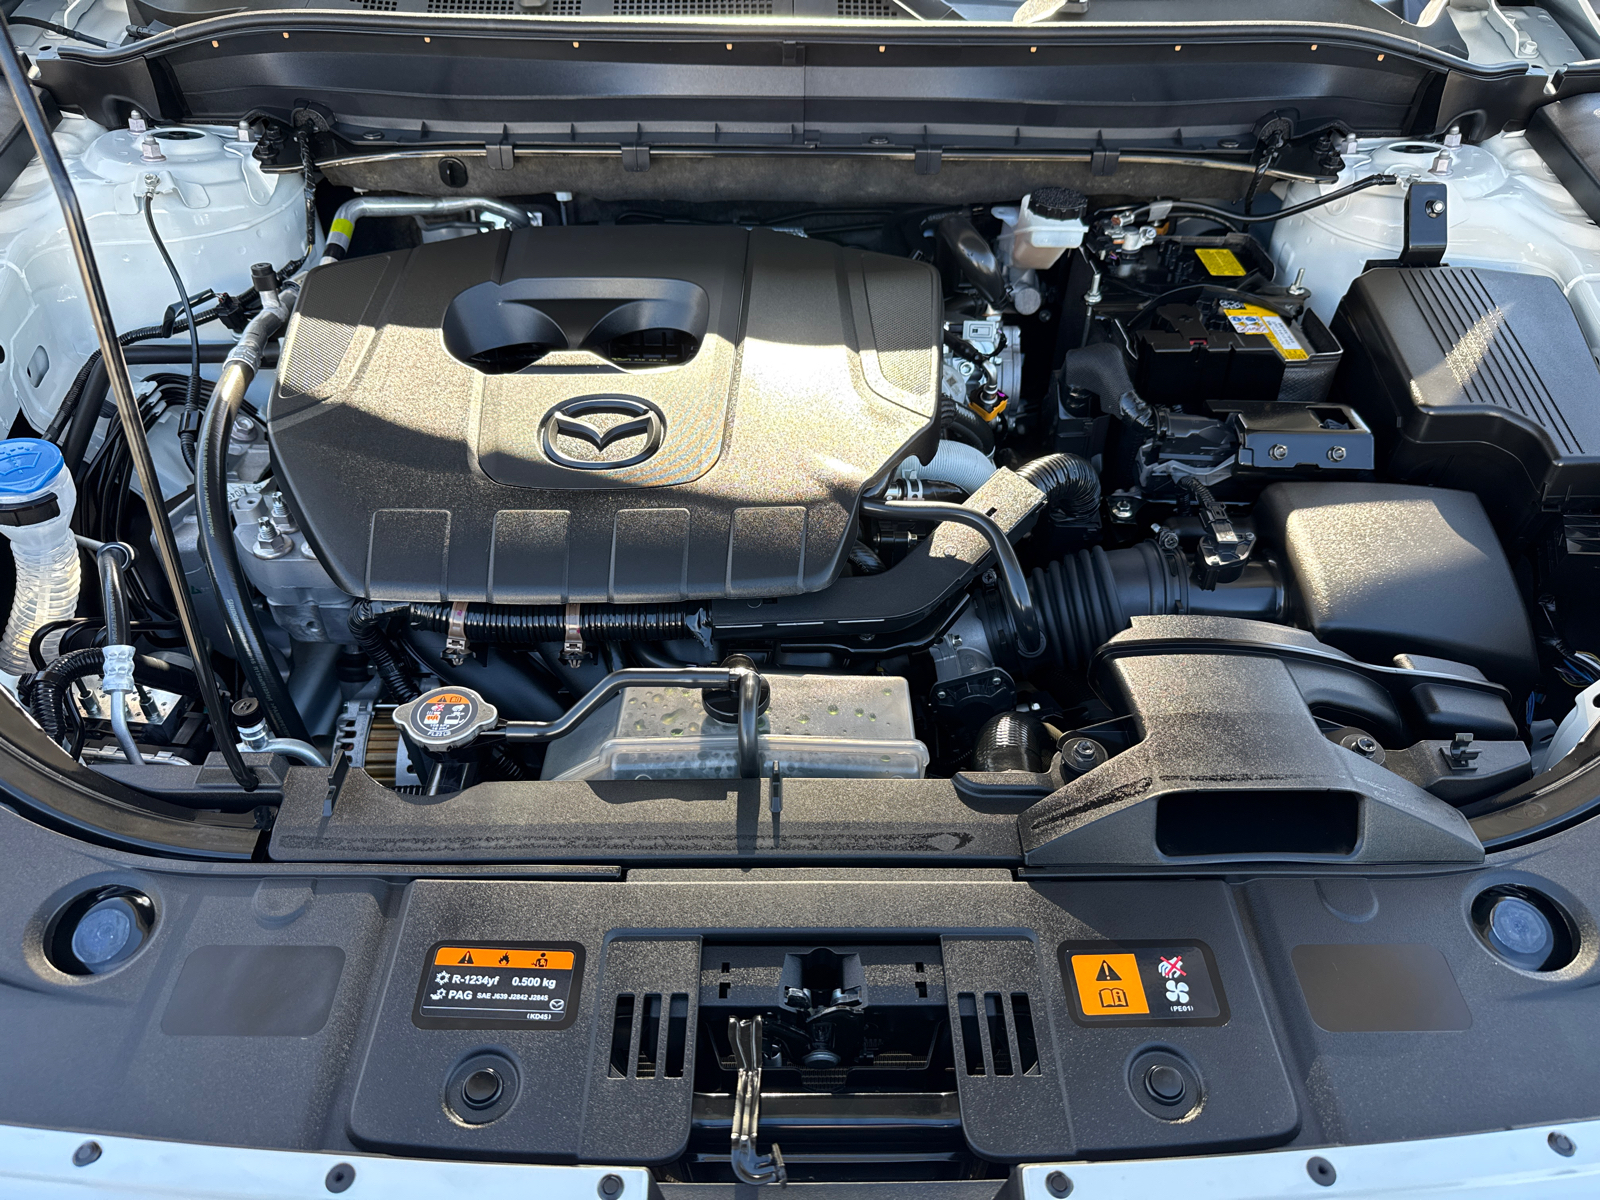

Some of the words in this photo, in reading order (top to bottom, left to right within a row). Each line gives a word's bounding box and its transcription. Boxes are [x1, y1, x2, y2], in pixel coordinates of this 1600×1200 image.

[452, 974, 500, 987] R-1234yf
[512, 976, 541, 986] 0.500
[542, 978, 556, 989] kg
[448, 990, 472, 1000] PAG
